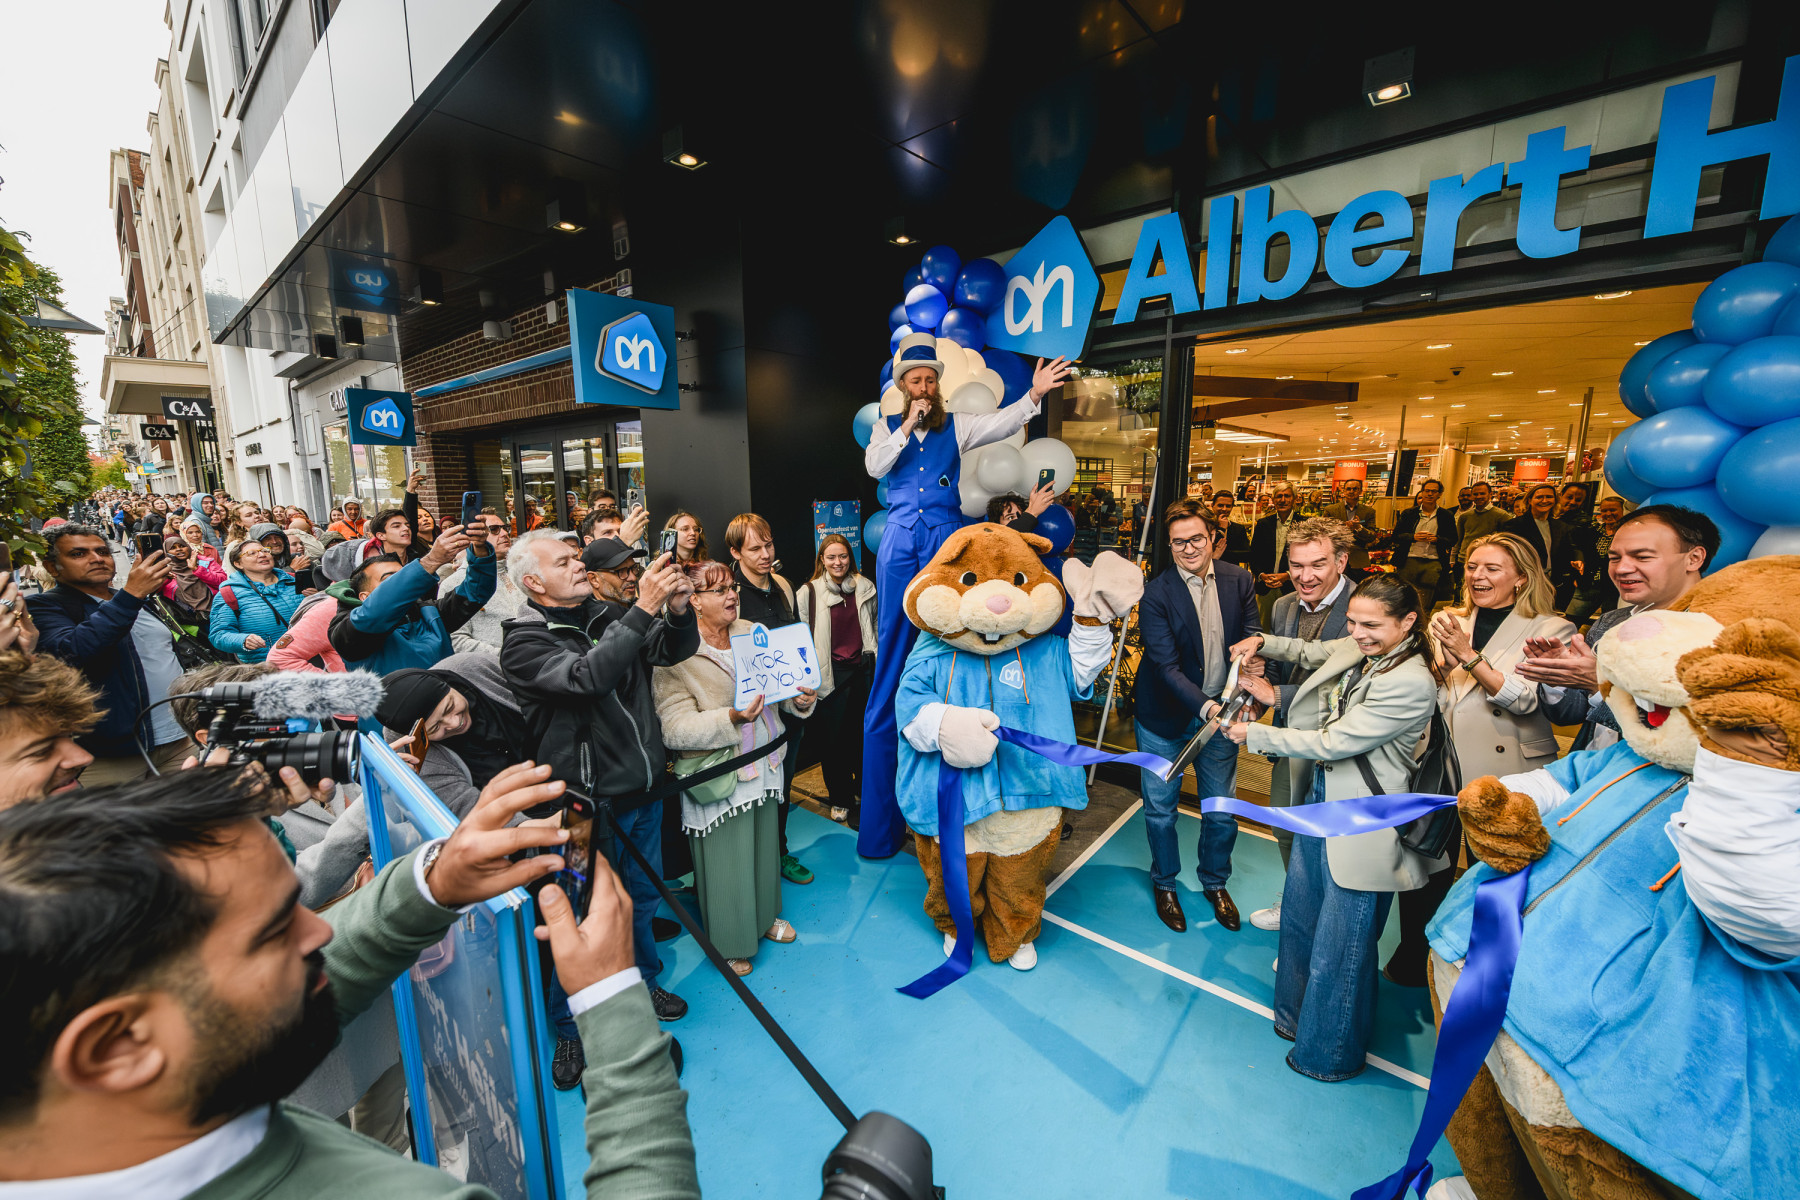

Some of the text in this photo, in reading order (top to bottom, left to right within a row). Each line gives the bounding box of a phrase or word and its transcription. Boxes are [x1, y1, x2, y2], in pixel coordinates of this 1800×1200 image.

[1112, 125, 1592, 325] Albert
[168, 400, 206, 417] C&A
[145, 426, 172, 438] C&A
